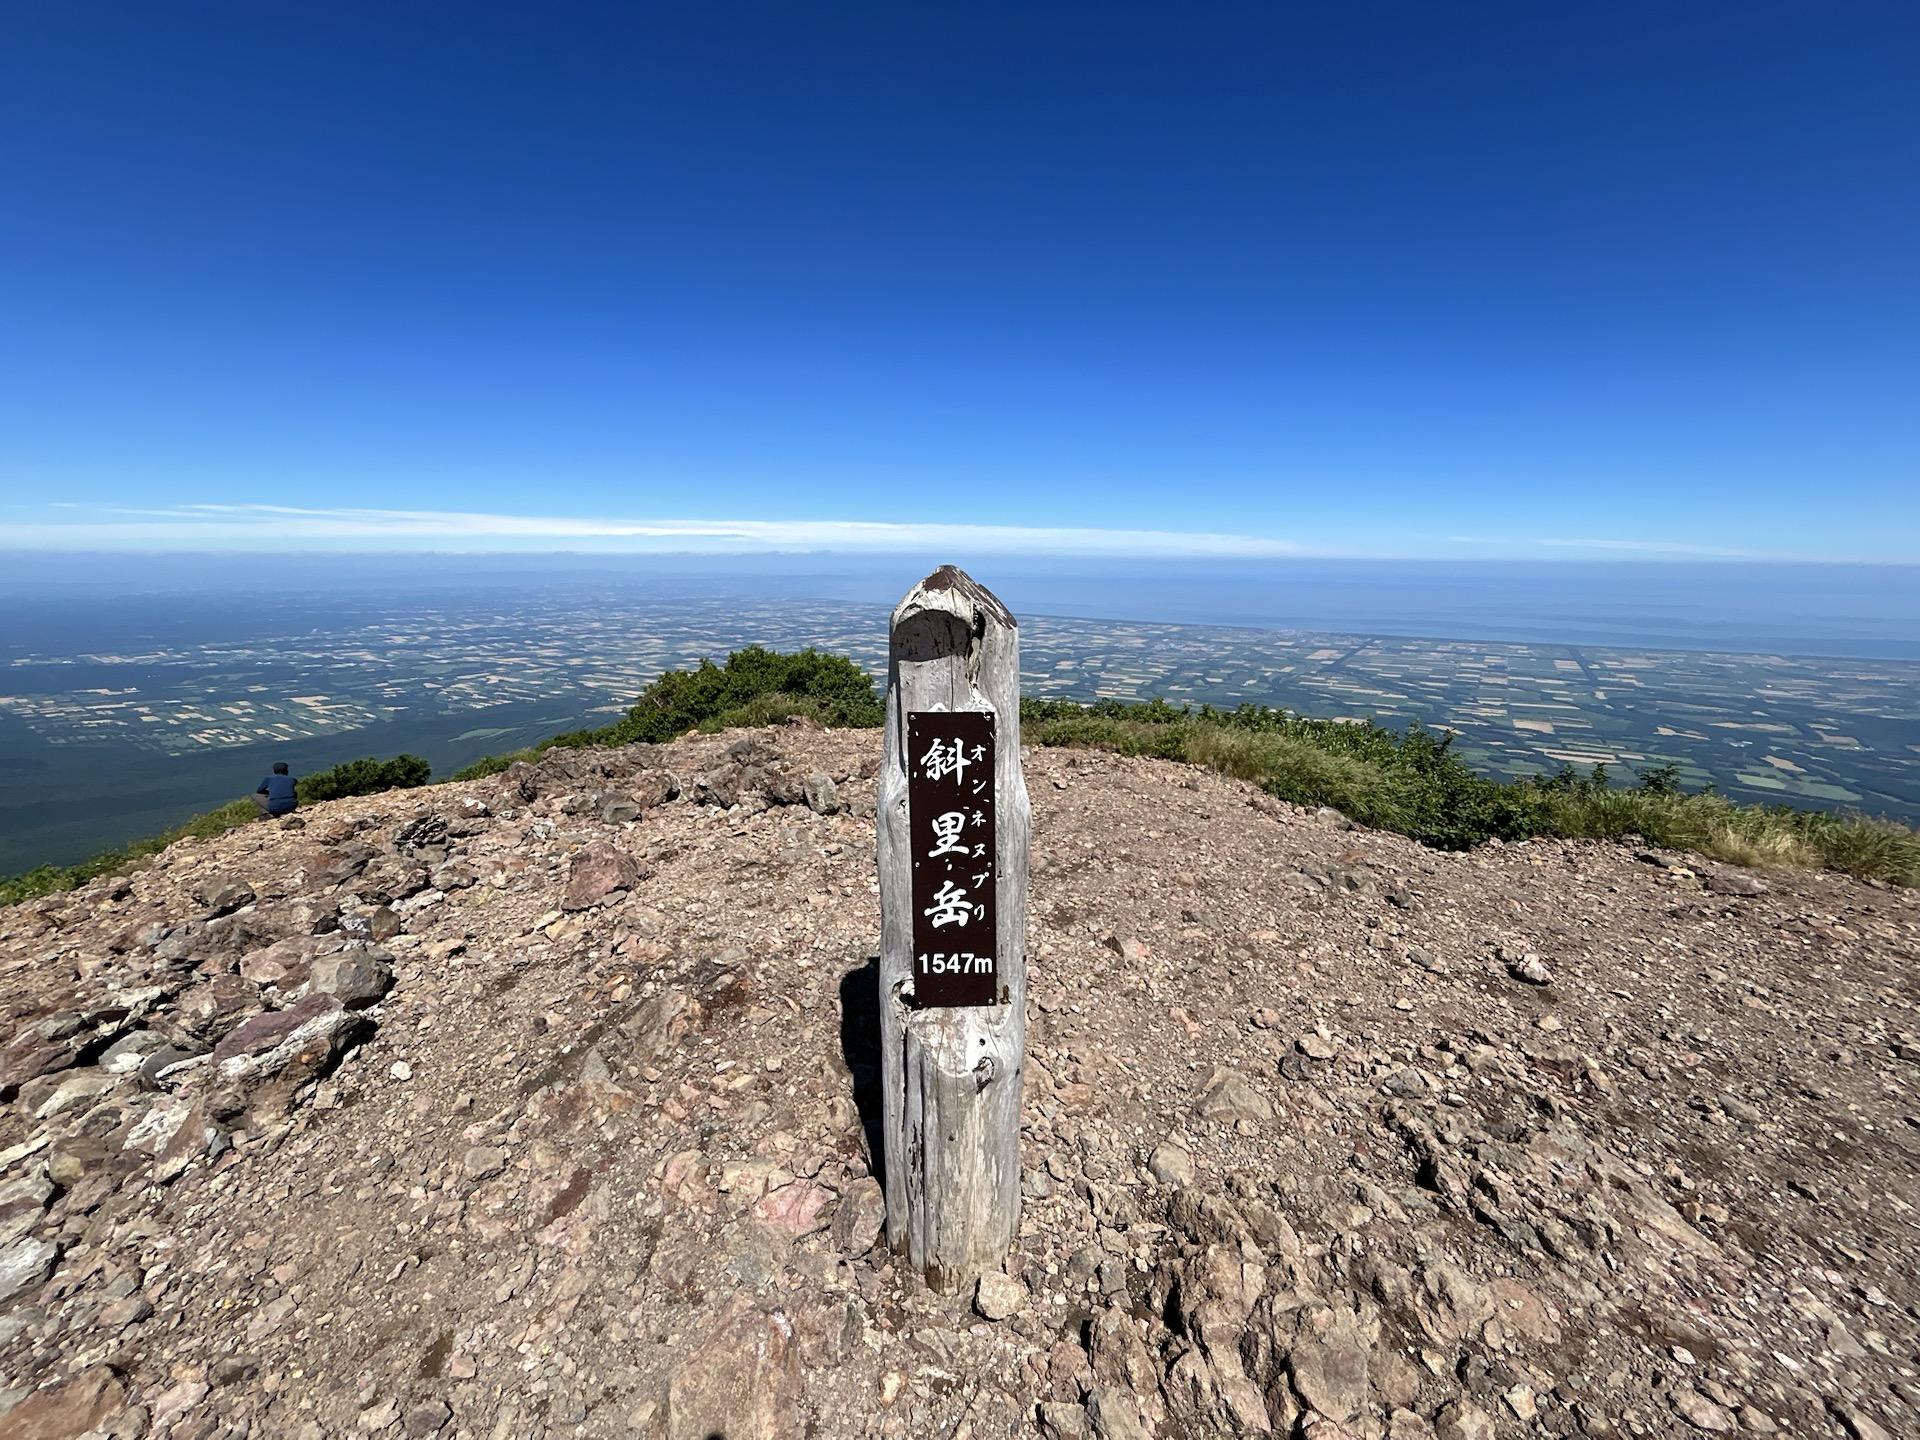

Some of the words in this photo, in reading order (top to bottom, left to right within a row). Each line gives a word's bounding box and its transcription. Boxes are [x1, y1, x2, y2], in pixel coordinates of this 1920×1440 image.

[920, 738, 973, 928] 斜里岳
[970, 744, 989, 921] オンネヌプリ
[918, 953, 993, 974] 1547m
